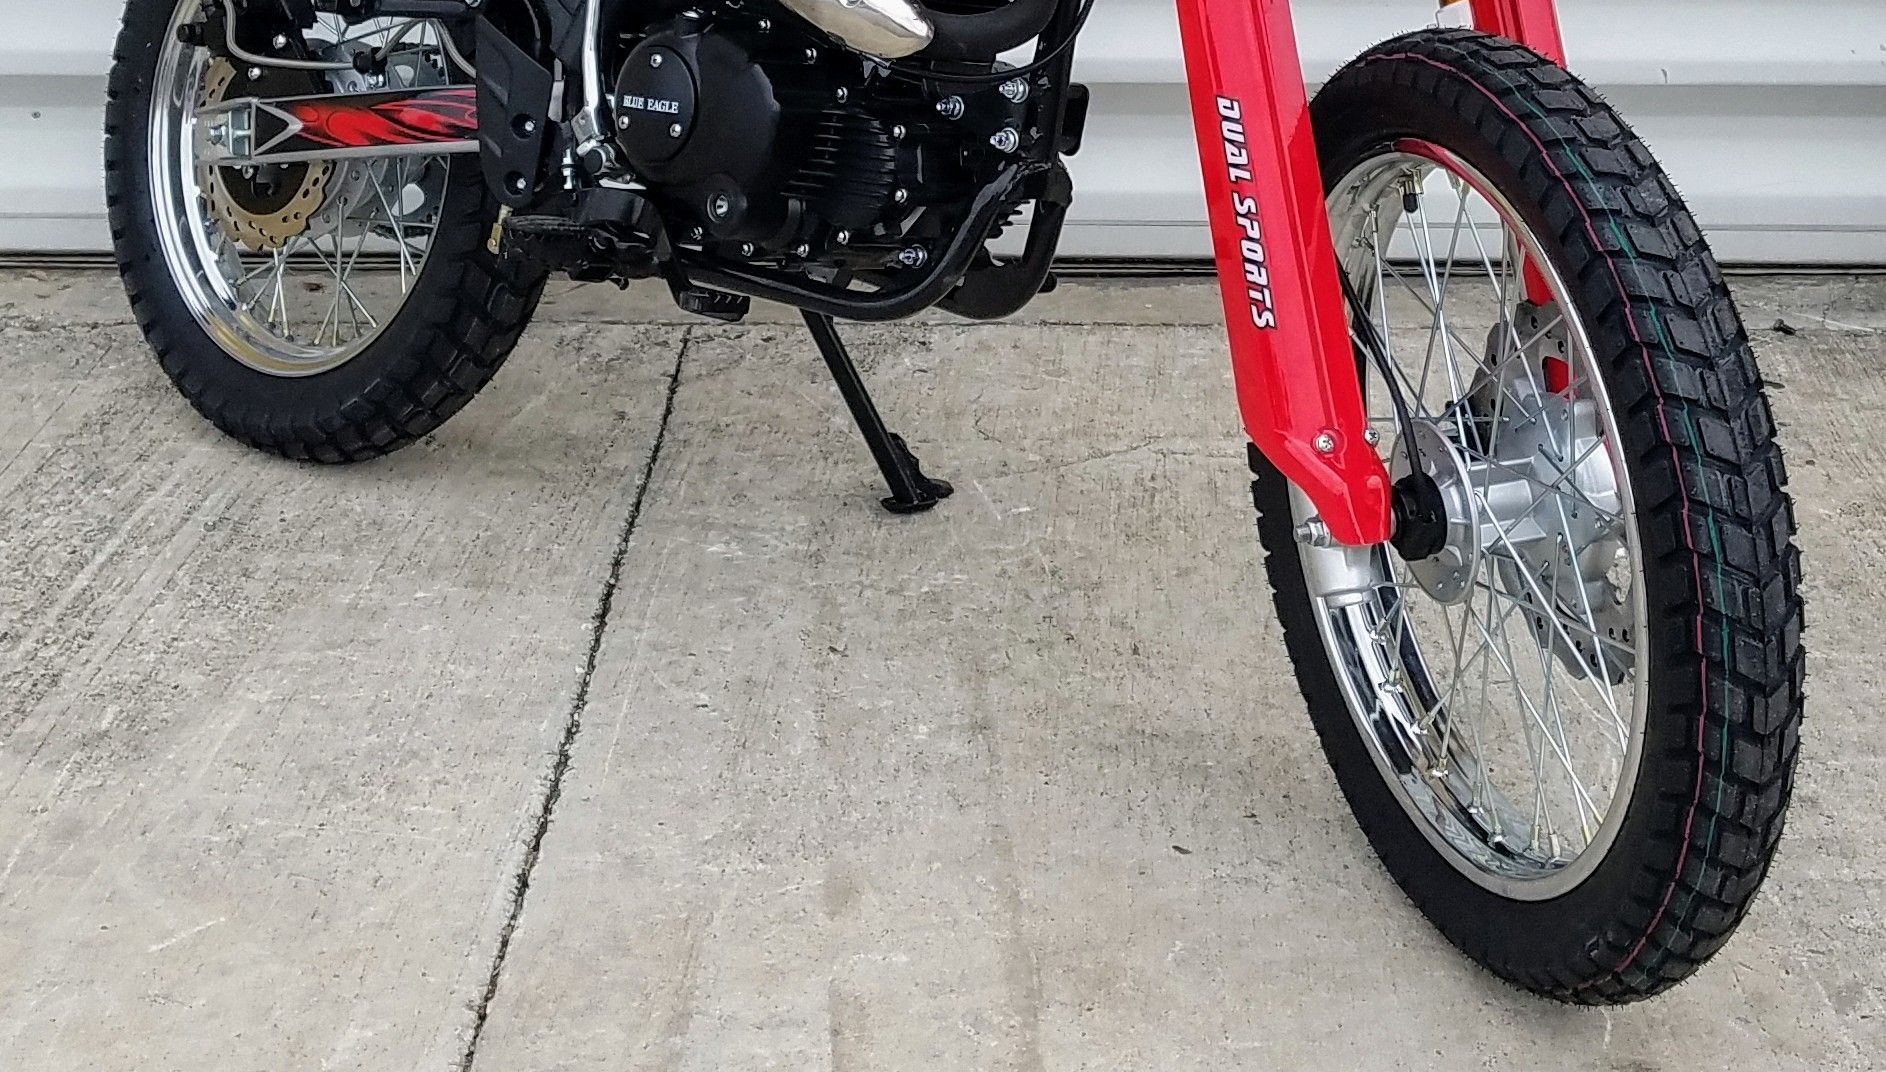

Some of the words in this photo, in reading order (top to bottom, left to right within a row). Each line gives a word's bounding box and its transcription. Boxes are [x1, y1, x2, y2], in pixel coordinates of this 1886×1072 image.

[623, 95, 644, 109] BLUE
[647, 98, 679, 114] EAGLE
[1216, 95, 1253, 183] DUAL
[1232, 191, 1276, 329] SPORTS
